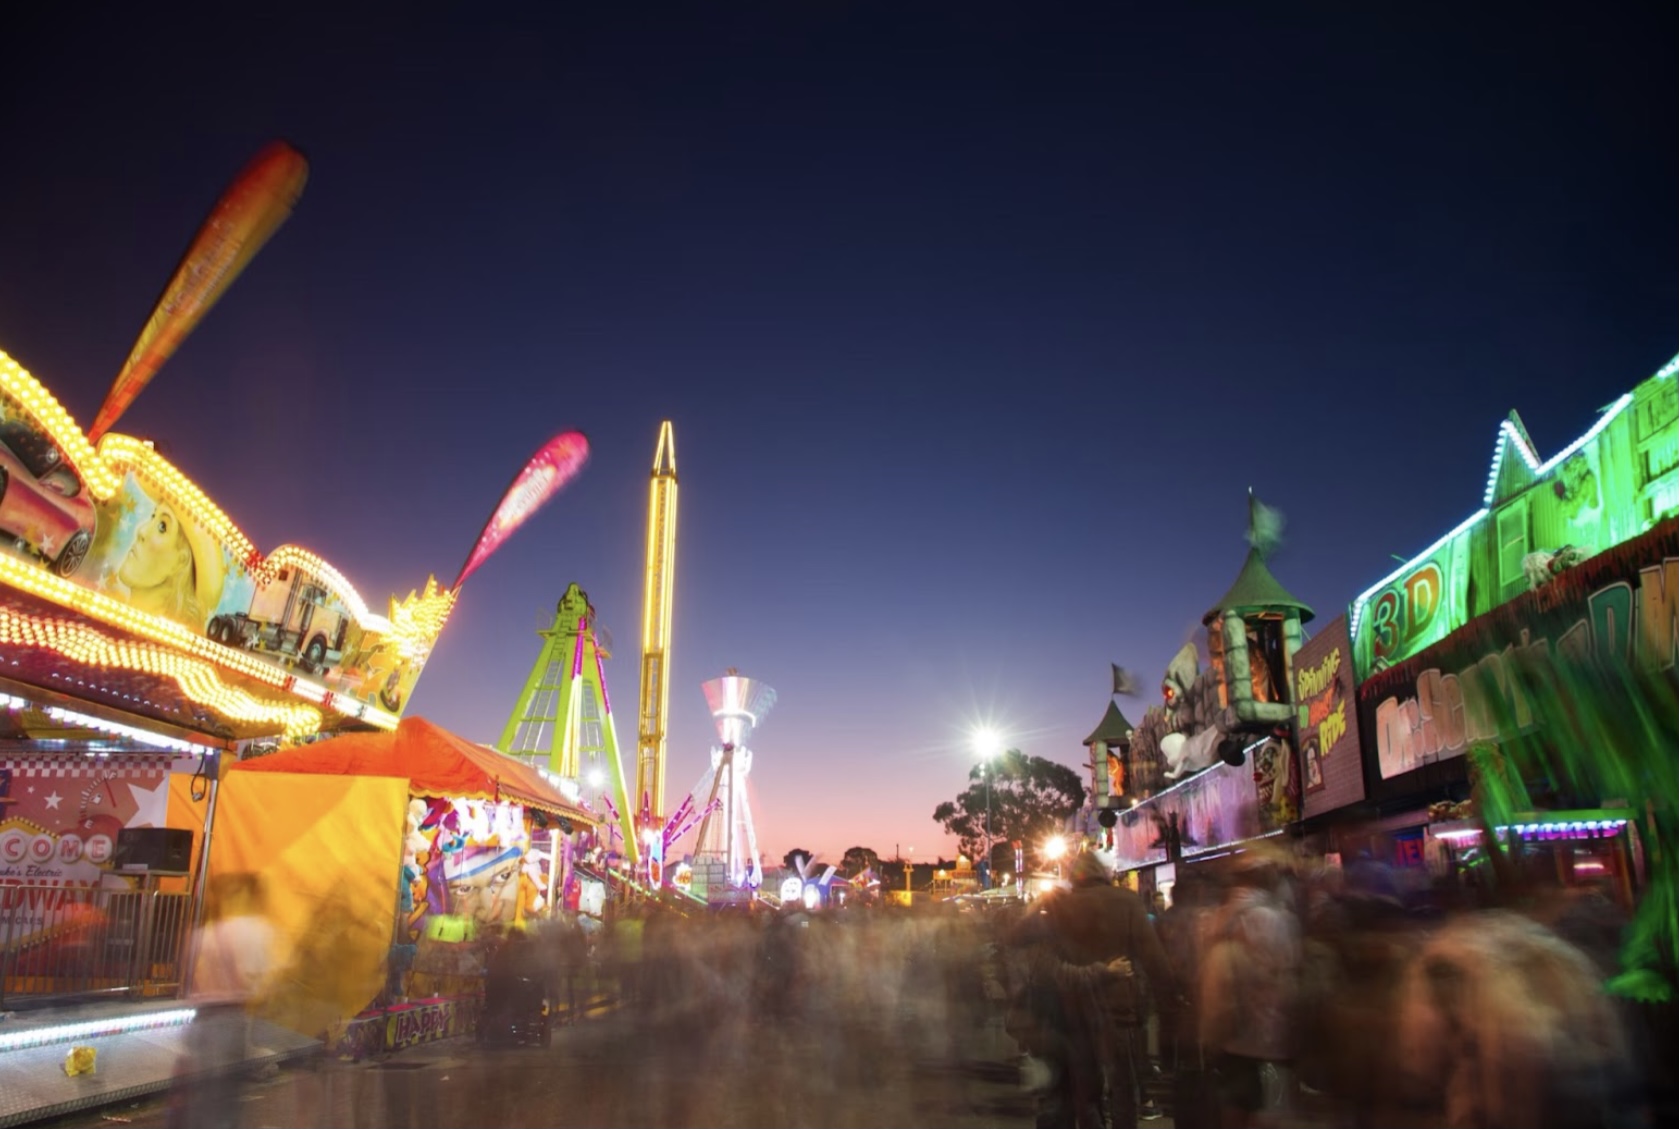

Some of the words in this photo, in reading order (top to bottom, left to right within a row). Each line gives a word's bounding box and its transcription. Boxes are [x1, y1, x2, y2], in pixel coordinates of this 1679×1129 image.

[1373, 562, 1443, 659] 3D
[4, 837, 106, 859] COME
[25, 864, 63, 877] Electric
[396, 1003, 451, 1043] HAPPY
